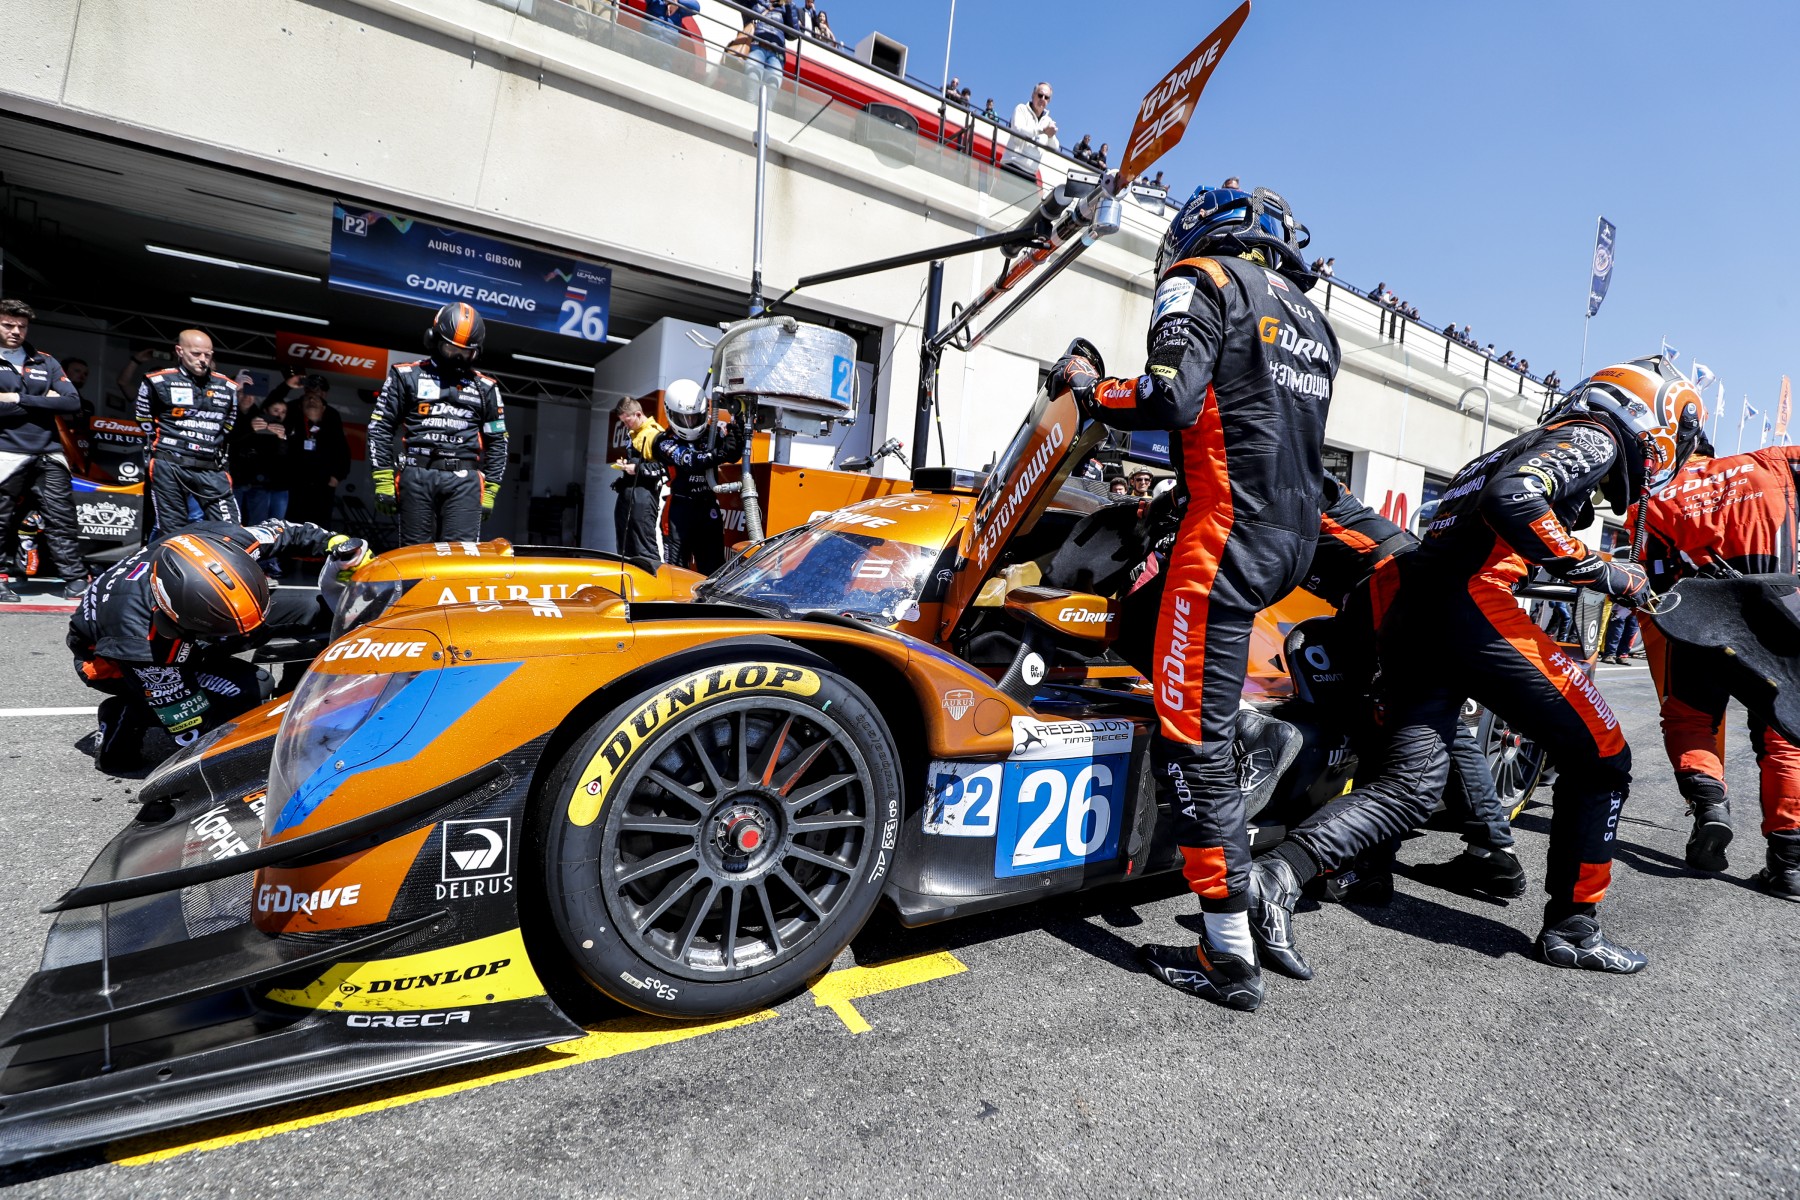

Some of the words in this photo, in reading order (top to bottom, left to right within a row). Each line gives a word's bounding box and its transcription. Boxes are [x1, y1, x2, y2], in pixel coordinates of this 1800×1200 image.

[1130, 93, 1190, 162] 26
[344, 217, 366, 234] P2
[428, 239, 462, 256] AURUS
[465, 250, 476, 259] 01
[485, 251, 522, 269] GIBSON
[406, 274, 474, 299] G-DRIVE
[476, 289, 536, 311] RACING
[559, 299, 604, 341] 26
[94, 431, 143, 444] AURUS
[423, 432, 464, 444] AURUS
[1030, 664, 1039, 672] Be
[173, 709, 189, 721] PIT
[943, 700, 975, 708] AURUS
[600, 664, 803, 776] DUNLOP
[934, 773, 993, 826] P2
[1011, 763, 1114, 867] 26
[435, 876, 514, 900] DELRUS
[366, 958, 511, 994] DUNLOP
[346, 1010, 471, 1028] ORECA
